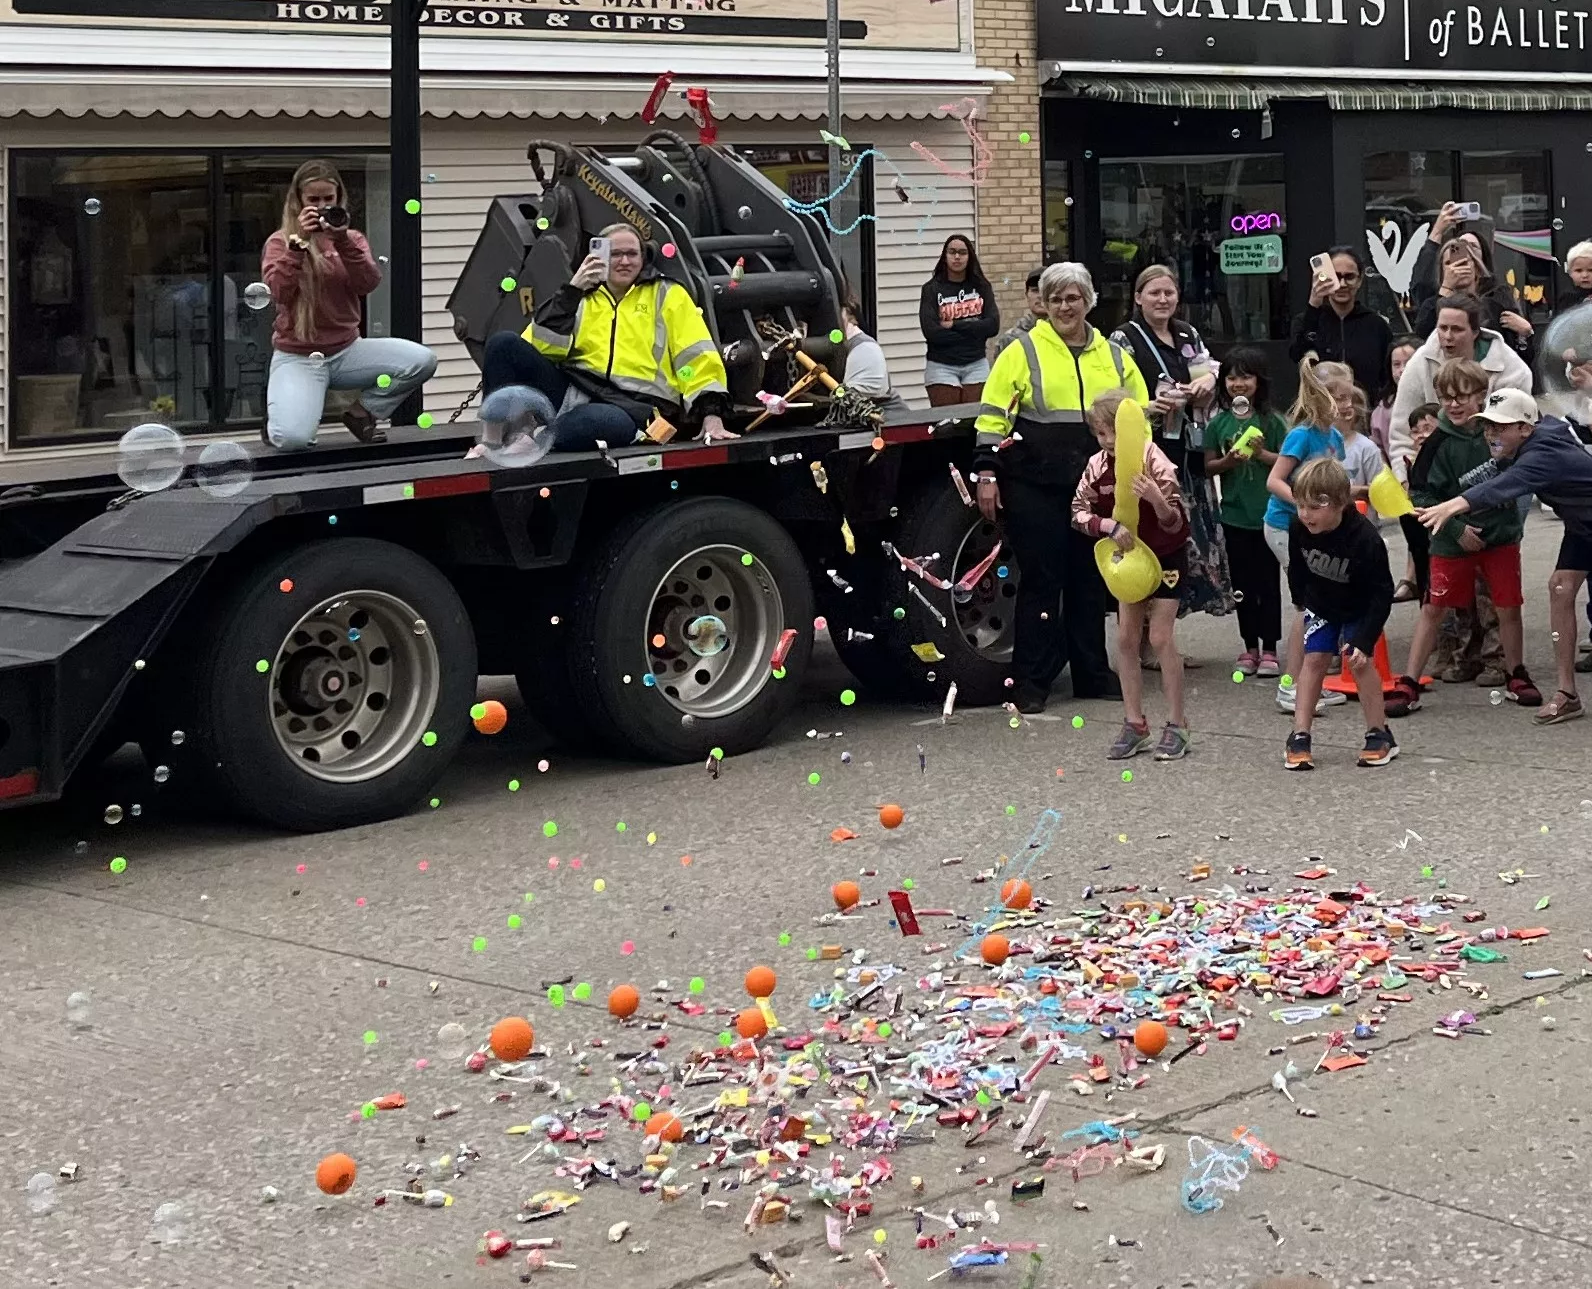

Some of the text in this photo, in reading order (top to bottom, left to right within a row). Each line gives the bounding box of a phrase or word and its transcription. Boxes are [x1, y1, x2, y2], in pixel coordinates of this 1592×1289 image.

[276, 2, 383, 22] HOME
[545, 11, 570, 28] &
[590, 13, 686, 32] GIFTS
[1429, 6, 1589, 57] of BALLET
[1231, 212, 1281, 235] open
